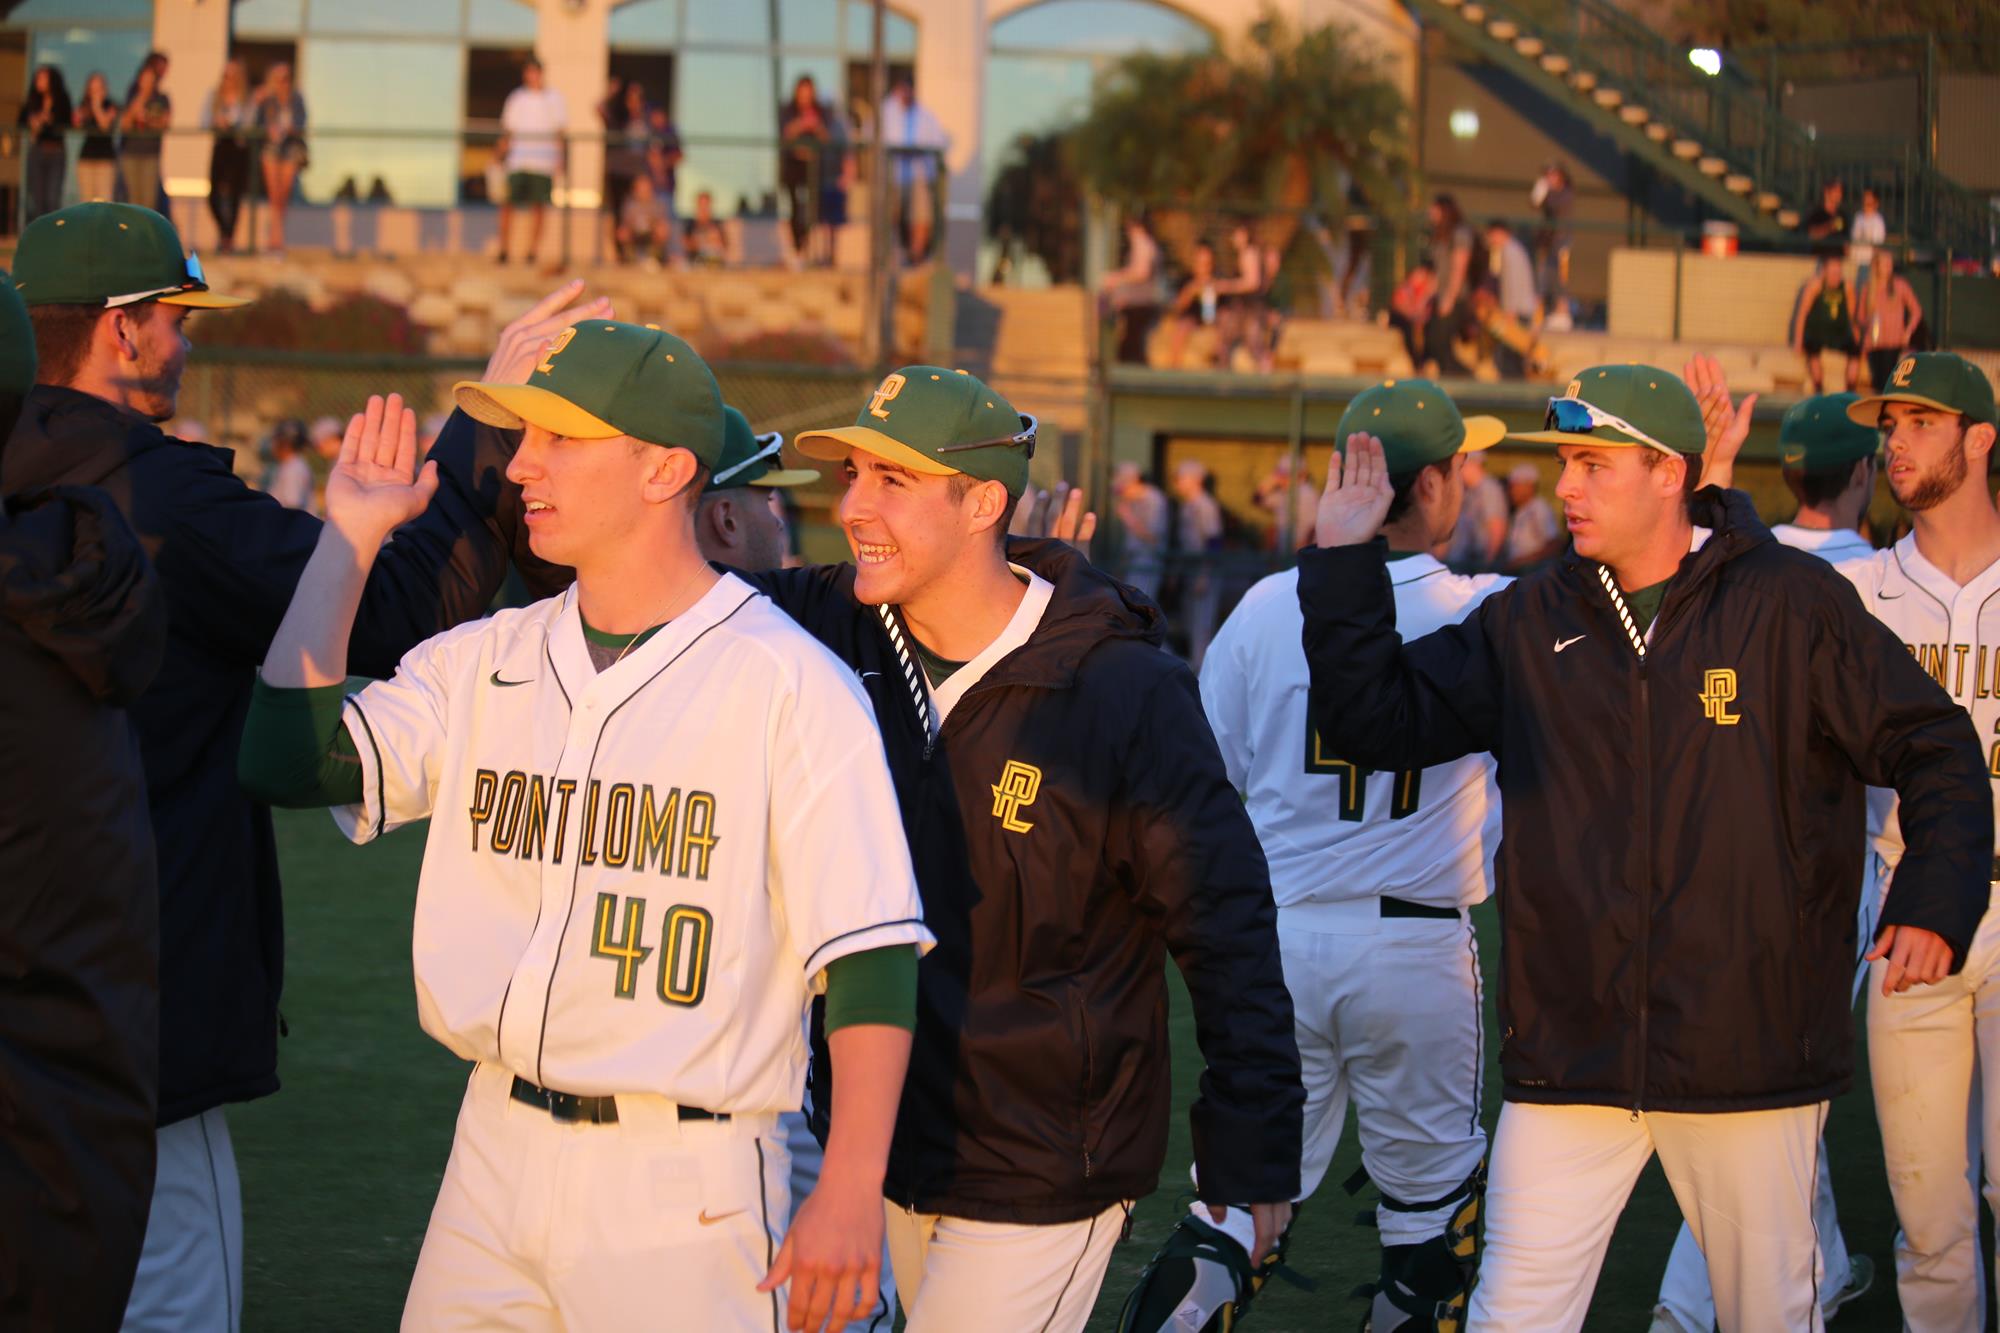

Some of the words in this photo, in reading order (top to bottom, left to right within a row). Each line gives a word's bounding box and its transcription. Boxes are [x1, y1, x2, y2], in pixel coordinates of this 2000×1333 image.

[469, 768, 577, 865] PONT
[581, 779, 721, 881] LOMA
[590, 892, 714, 1010] 40
